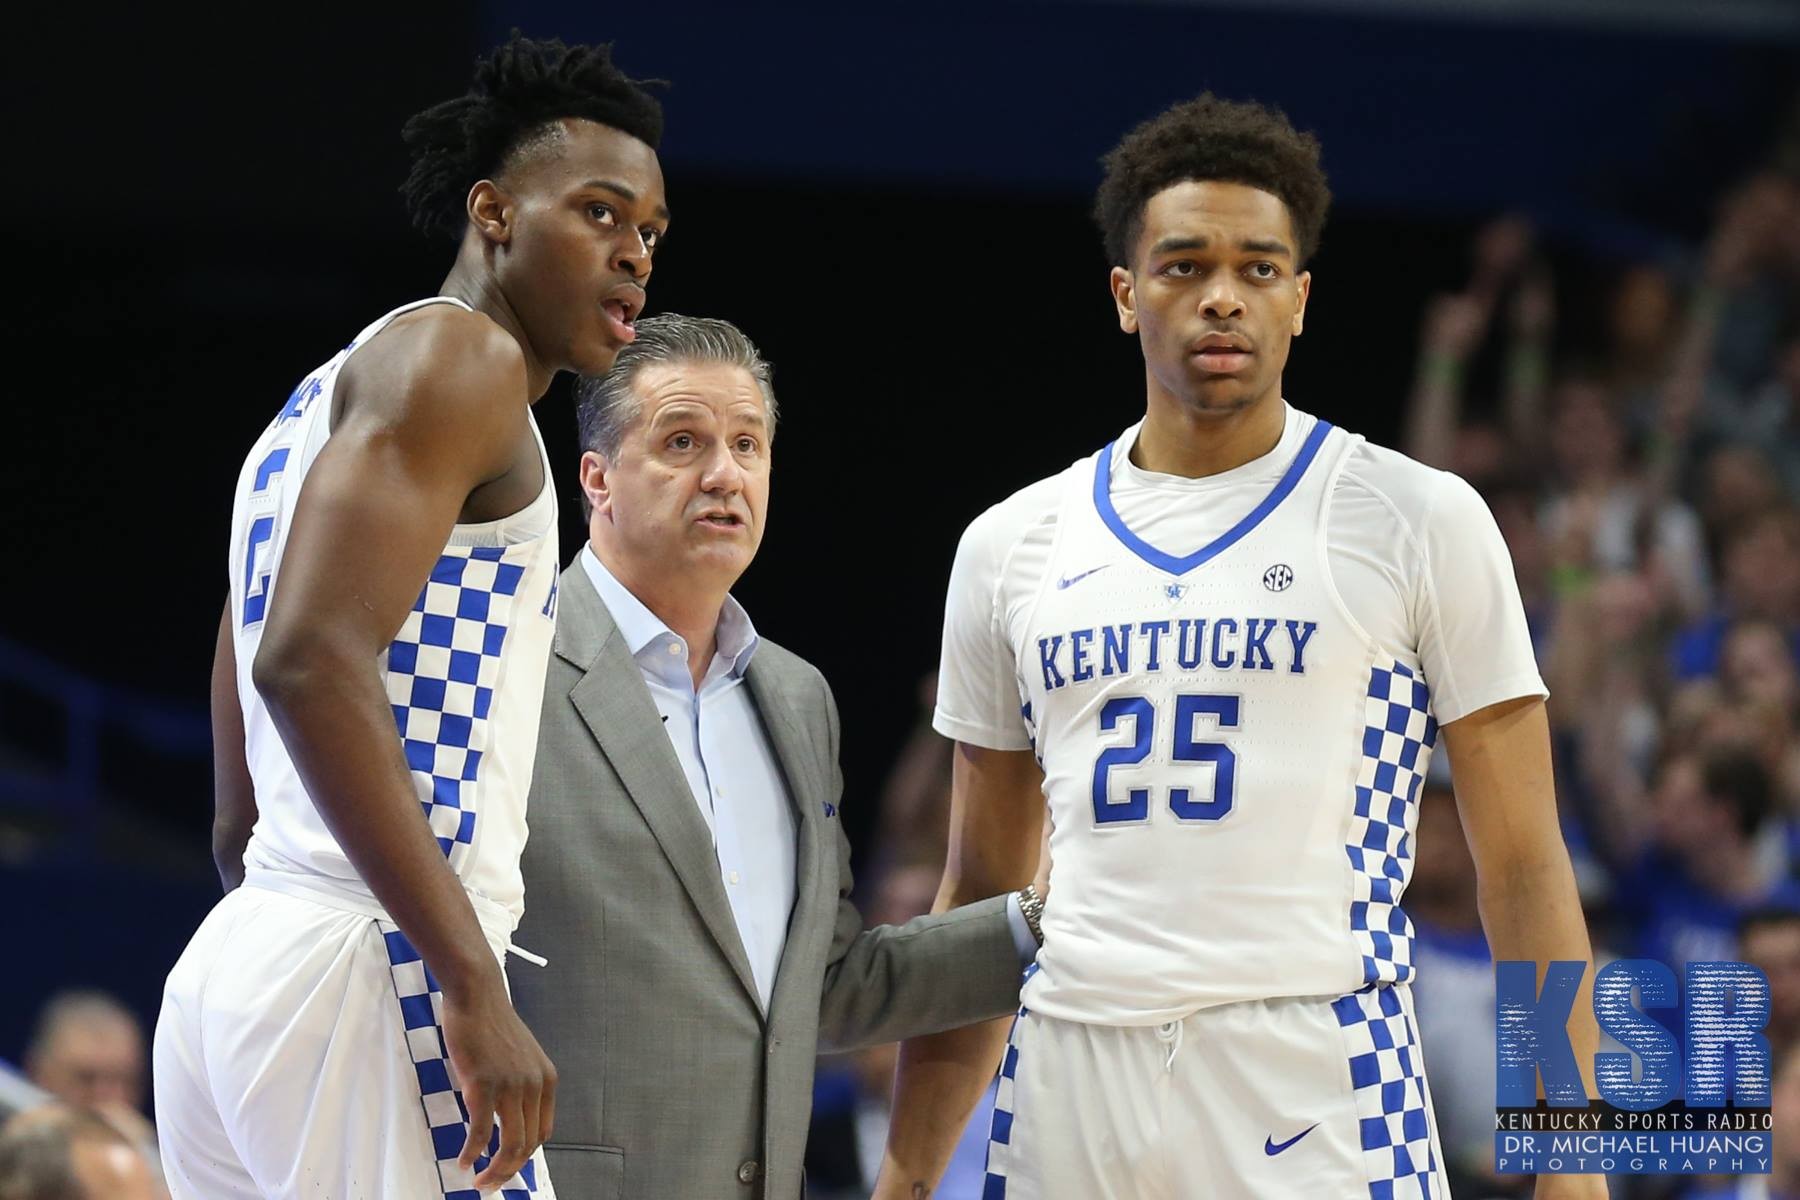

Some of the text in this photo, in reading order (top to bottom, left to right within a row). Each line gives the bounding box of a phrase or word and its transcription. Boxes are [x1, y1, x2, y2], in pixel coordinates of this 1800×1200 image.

[1263, 564, 1293, 592] SEC
[1038, 618, 1317, 691] KENTUCKY
[1092, 694, 1241, 824] 25
